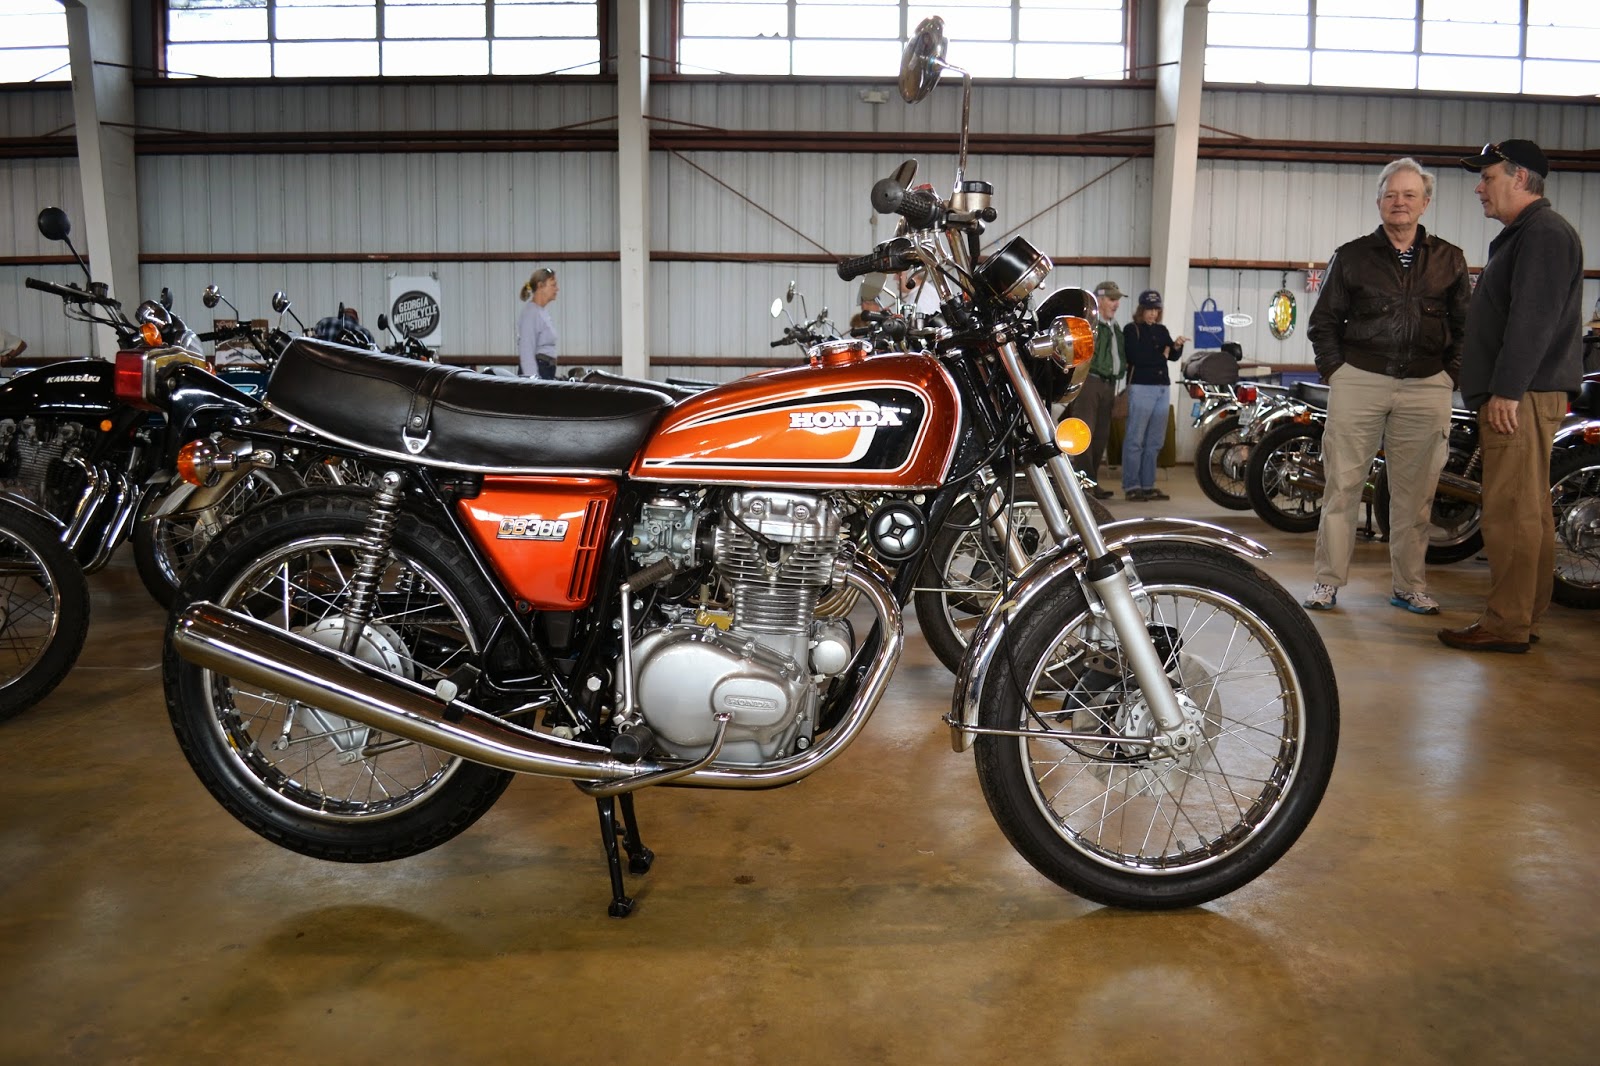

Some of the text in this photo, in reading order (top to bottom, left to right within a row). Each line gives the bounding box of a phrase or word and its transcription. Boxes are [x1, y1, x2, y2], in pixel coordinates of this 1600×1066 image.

[398, 296, 429, 313] GEORGIA
[393, 304, 438, 325] MOTORCYCLE
[46, 374, 101, 384] KAWASAKI
[789, 410, 903, 428] HONDA
[728, 697, 774, 708] HONDA
